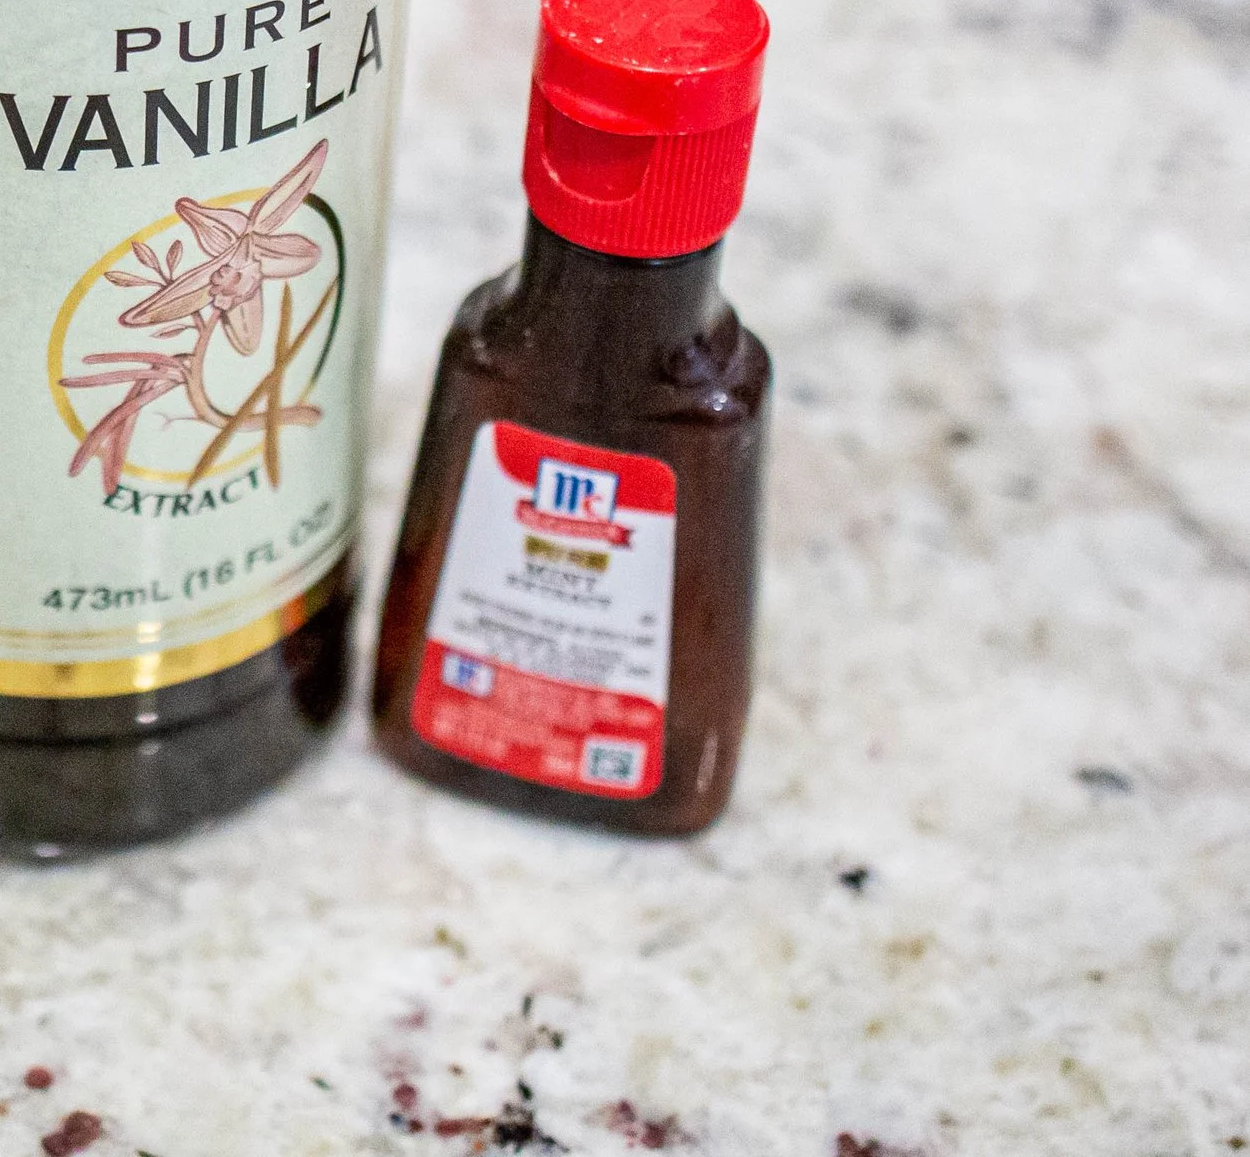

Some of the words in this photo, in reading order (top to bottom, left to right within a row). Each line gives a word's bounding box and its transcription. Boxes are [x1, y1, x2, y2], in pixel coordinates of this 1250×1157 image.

[102, 467, 262, 518] EXTRACT
[43, 580, 171, 613] 473mL
[182, 561, 236, 601] (16
[245, 541, 278, 573] FL
